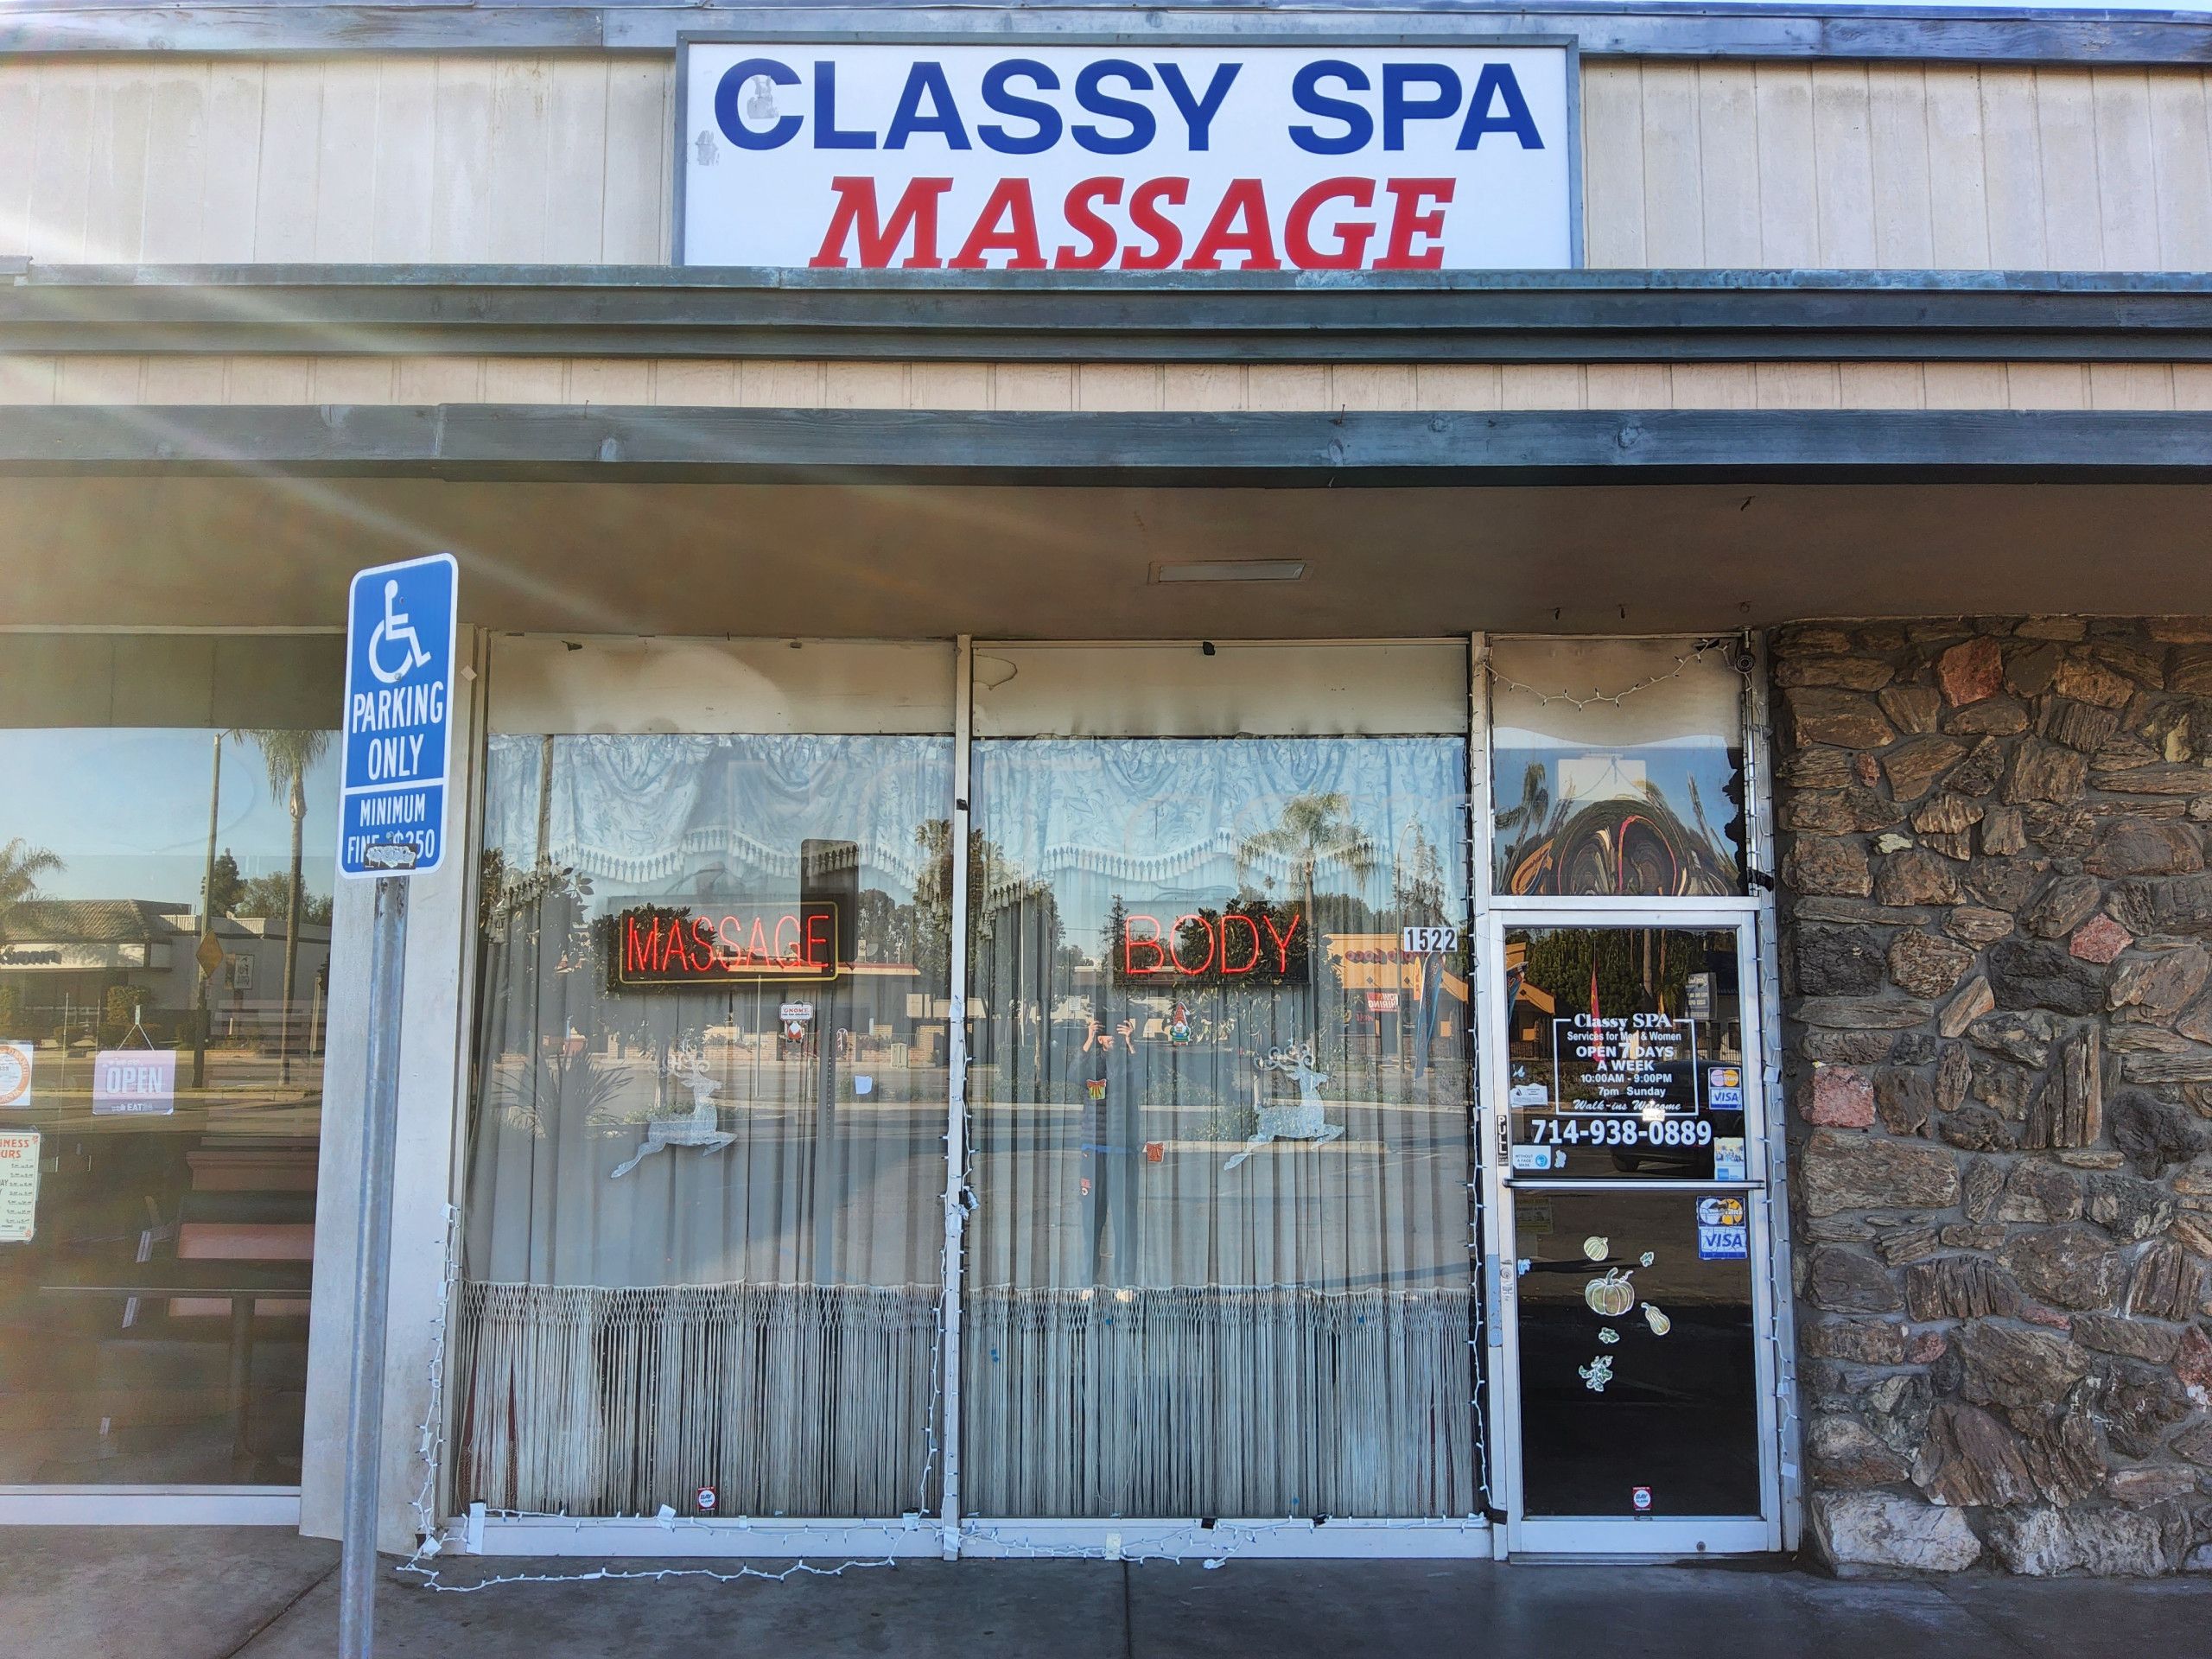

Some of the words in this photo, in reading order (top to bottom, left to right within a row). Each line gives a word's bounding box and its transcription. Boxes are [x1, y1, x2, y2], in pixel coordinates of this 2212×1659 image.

[714, 58, 1243, 154] CLASSY
[1287, 59, 1546, 155] SPA
[809, 175, 1457, 270] MASSAGE
[353, 681, 443, 734] PARKING
[368, 734, 424, 779] ONLY
[360, 793, 426, 827] MINIMUM
[627, 915, 830, 972] MASSAGE
[1125, 913, 1300, 976] BODY
[1407, 928, 1456, 951] 1522
[1574, 1013, 1628, 1031] Classy
[1633, 1014, 1672, 1027] SPA
[1567, 1031, 1604, 1041] Services
[1605, 1031, 1618, 1041] for
[1620, 1031, 1638, 1041] Men
[1642, 1032, 1648, 1041] &
[1649, 1032, 1681, 1041] Women
[1576, 1046, 1617, 1058] OPEN
[1618, 1042, 1631, 1058] 7
[1636, 1046, 1675, 1058] DAYS
[1597, 1060, 1607, 1071] A
[1611, 1060, 1655, 1071] WEEK
[105, 1066, 162, 1094] OPEN
[1580, 1073, 1624, 1083] 10:00AM
[1634, 1074, 1673, 1084] 9:00PM
[1599, 1086, 1619, 1096] 7pm
[1627, 1086, 1666, 1097] Sunday
[1714, 1092, 1738, 1102] VISA
[1573, 1099, 1628, 1110] Walk-ins
[1498, 1116, 1507, 1154] PULL
[1531, 1119, 1712, 1145] 714-938-0889
[1706, 1233, 1743, 1248] VISA
